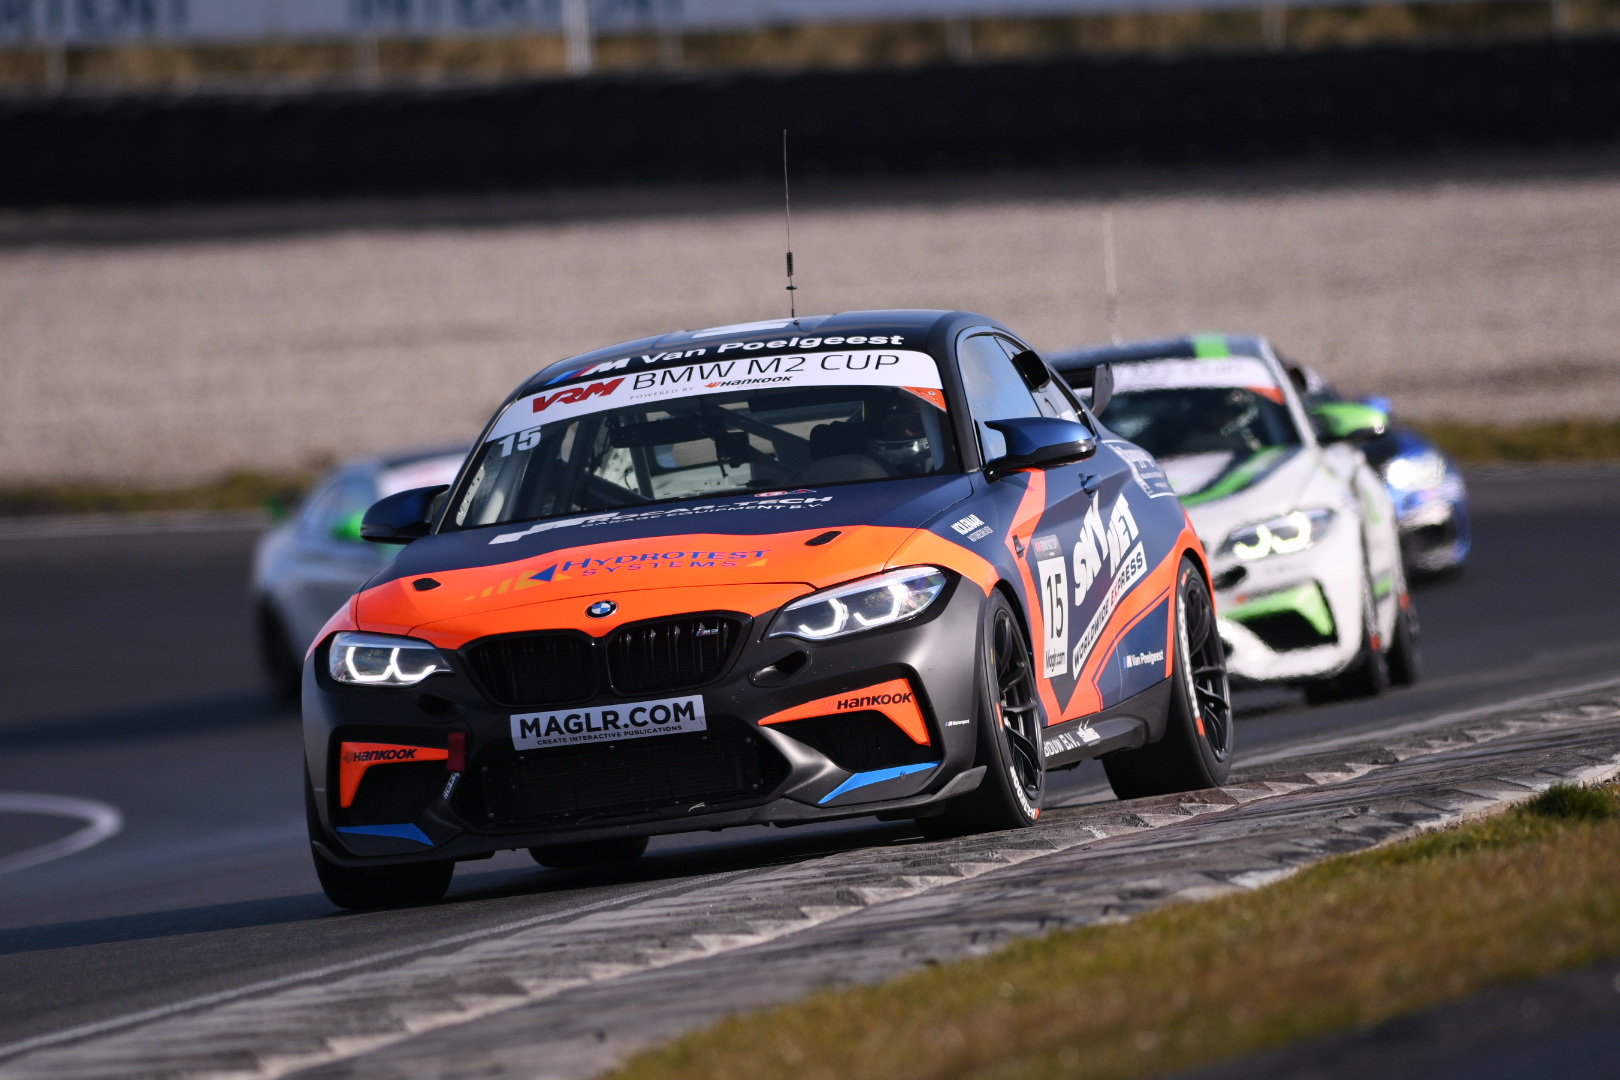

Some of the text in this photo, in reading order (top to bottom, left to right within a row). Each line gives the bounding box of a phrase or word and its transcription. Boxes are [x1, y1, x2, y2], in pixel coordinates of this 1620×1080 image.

[641, 348, 706, 364] Van
[717, 335, 904, 353] Poelgeest
[633, 354, 900, 391] BMW M2 CUP
[533, 377, 626, 413] VRM
[629, 389, 678, 400] POWERED
[498, 425, 542, 458] 15
[666, 504, 786, 517] EQUIPMENT
[562, 549, 771, 571] HYDROTEST
[582, 561, 738, 576] SYSTEMS
[1047, 573, 1064, 639] 15
[1074, 551, 1143, 669] WORLDWIDE EXPRESS
[519, 701, 695, 739] MAGLR.COM
[537, 724, 683, 746] CREATE INTERACTIVE PUBLICATIONS
